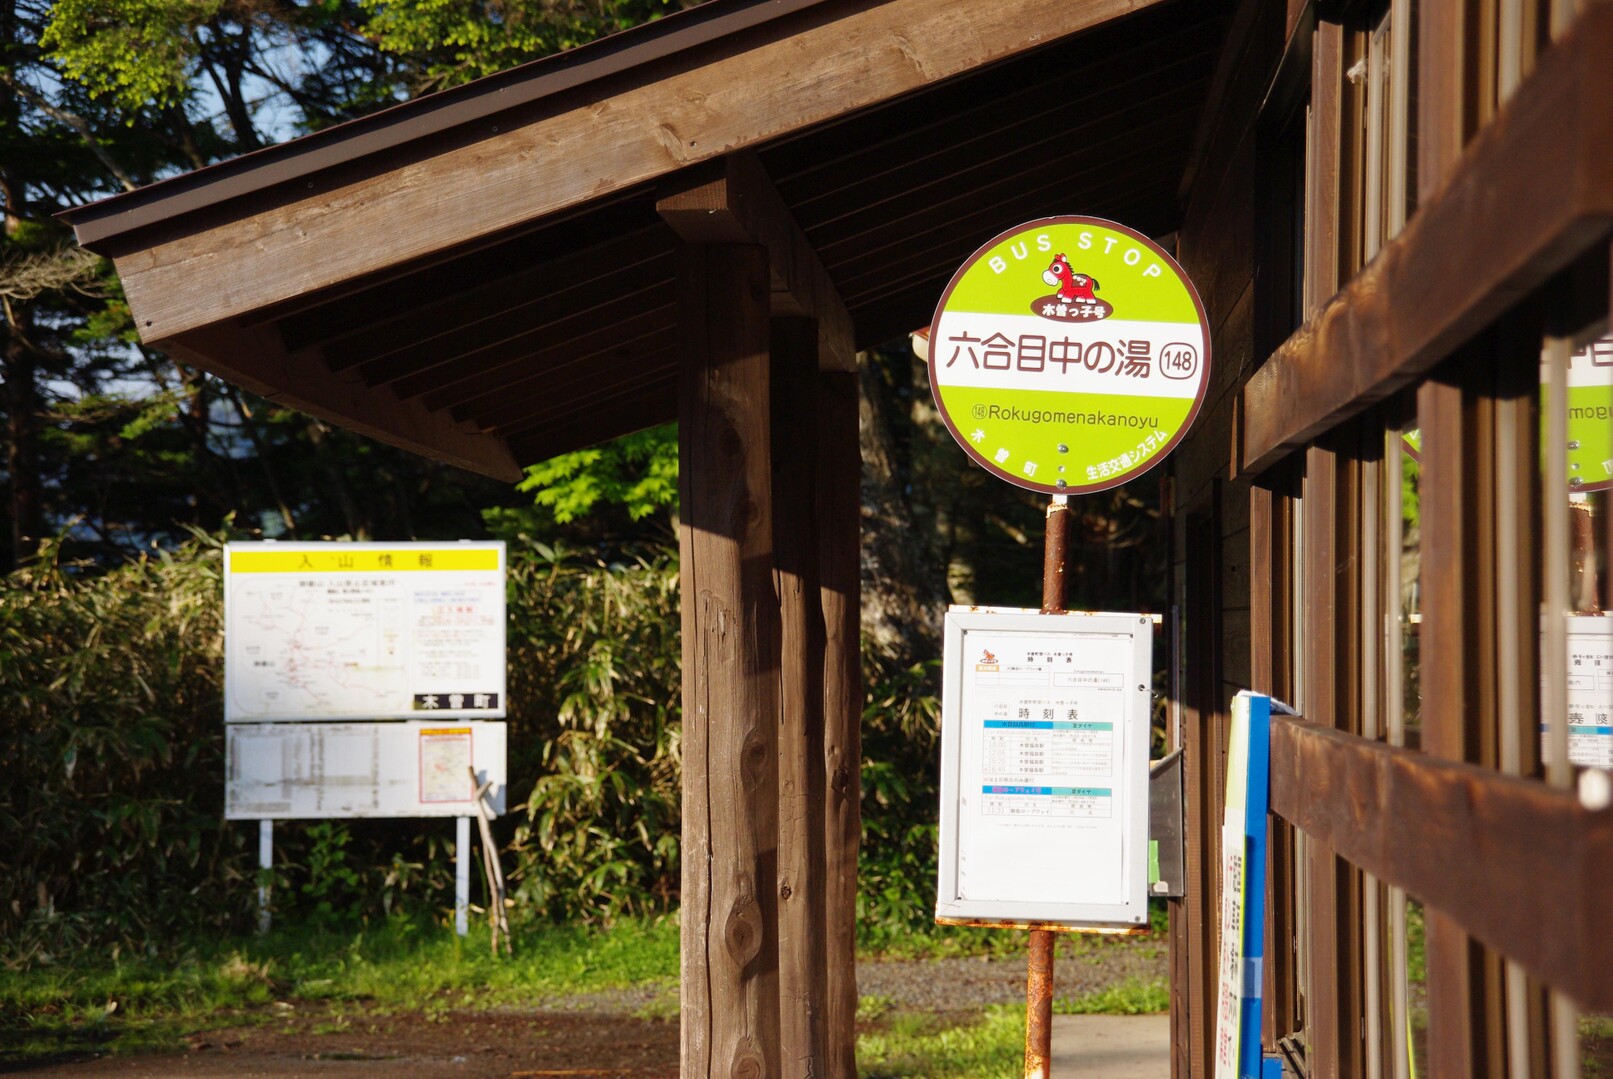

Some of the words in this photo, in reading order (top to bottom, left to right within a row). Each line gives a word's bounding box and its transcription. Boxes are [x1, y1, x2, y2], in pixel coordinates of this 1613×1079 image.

[988, 233, 1053, 275] BUS
[1078, 231, 1162, 281] STOP
[946, 330, 1151, 379] 六合目中の湯
[1086, 429, 1168, 480] 生活交通システム
[1018, 708, 1079, 720] 時刻表
